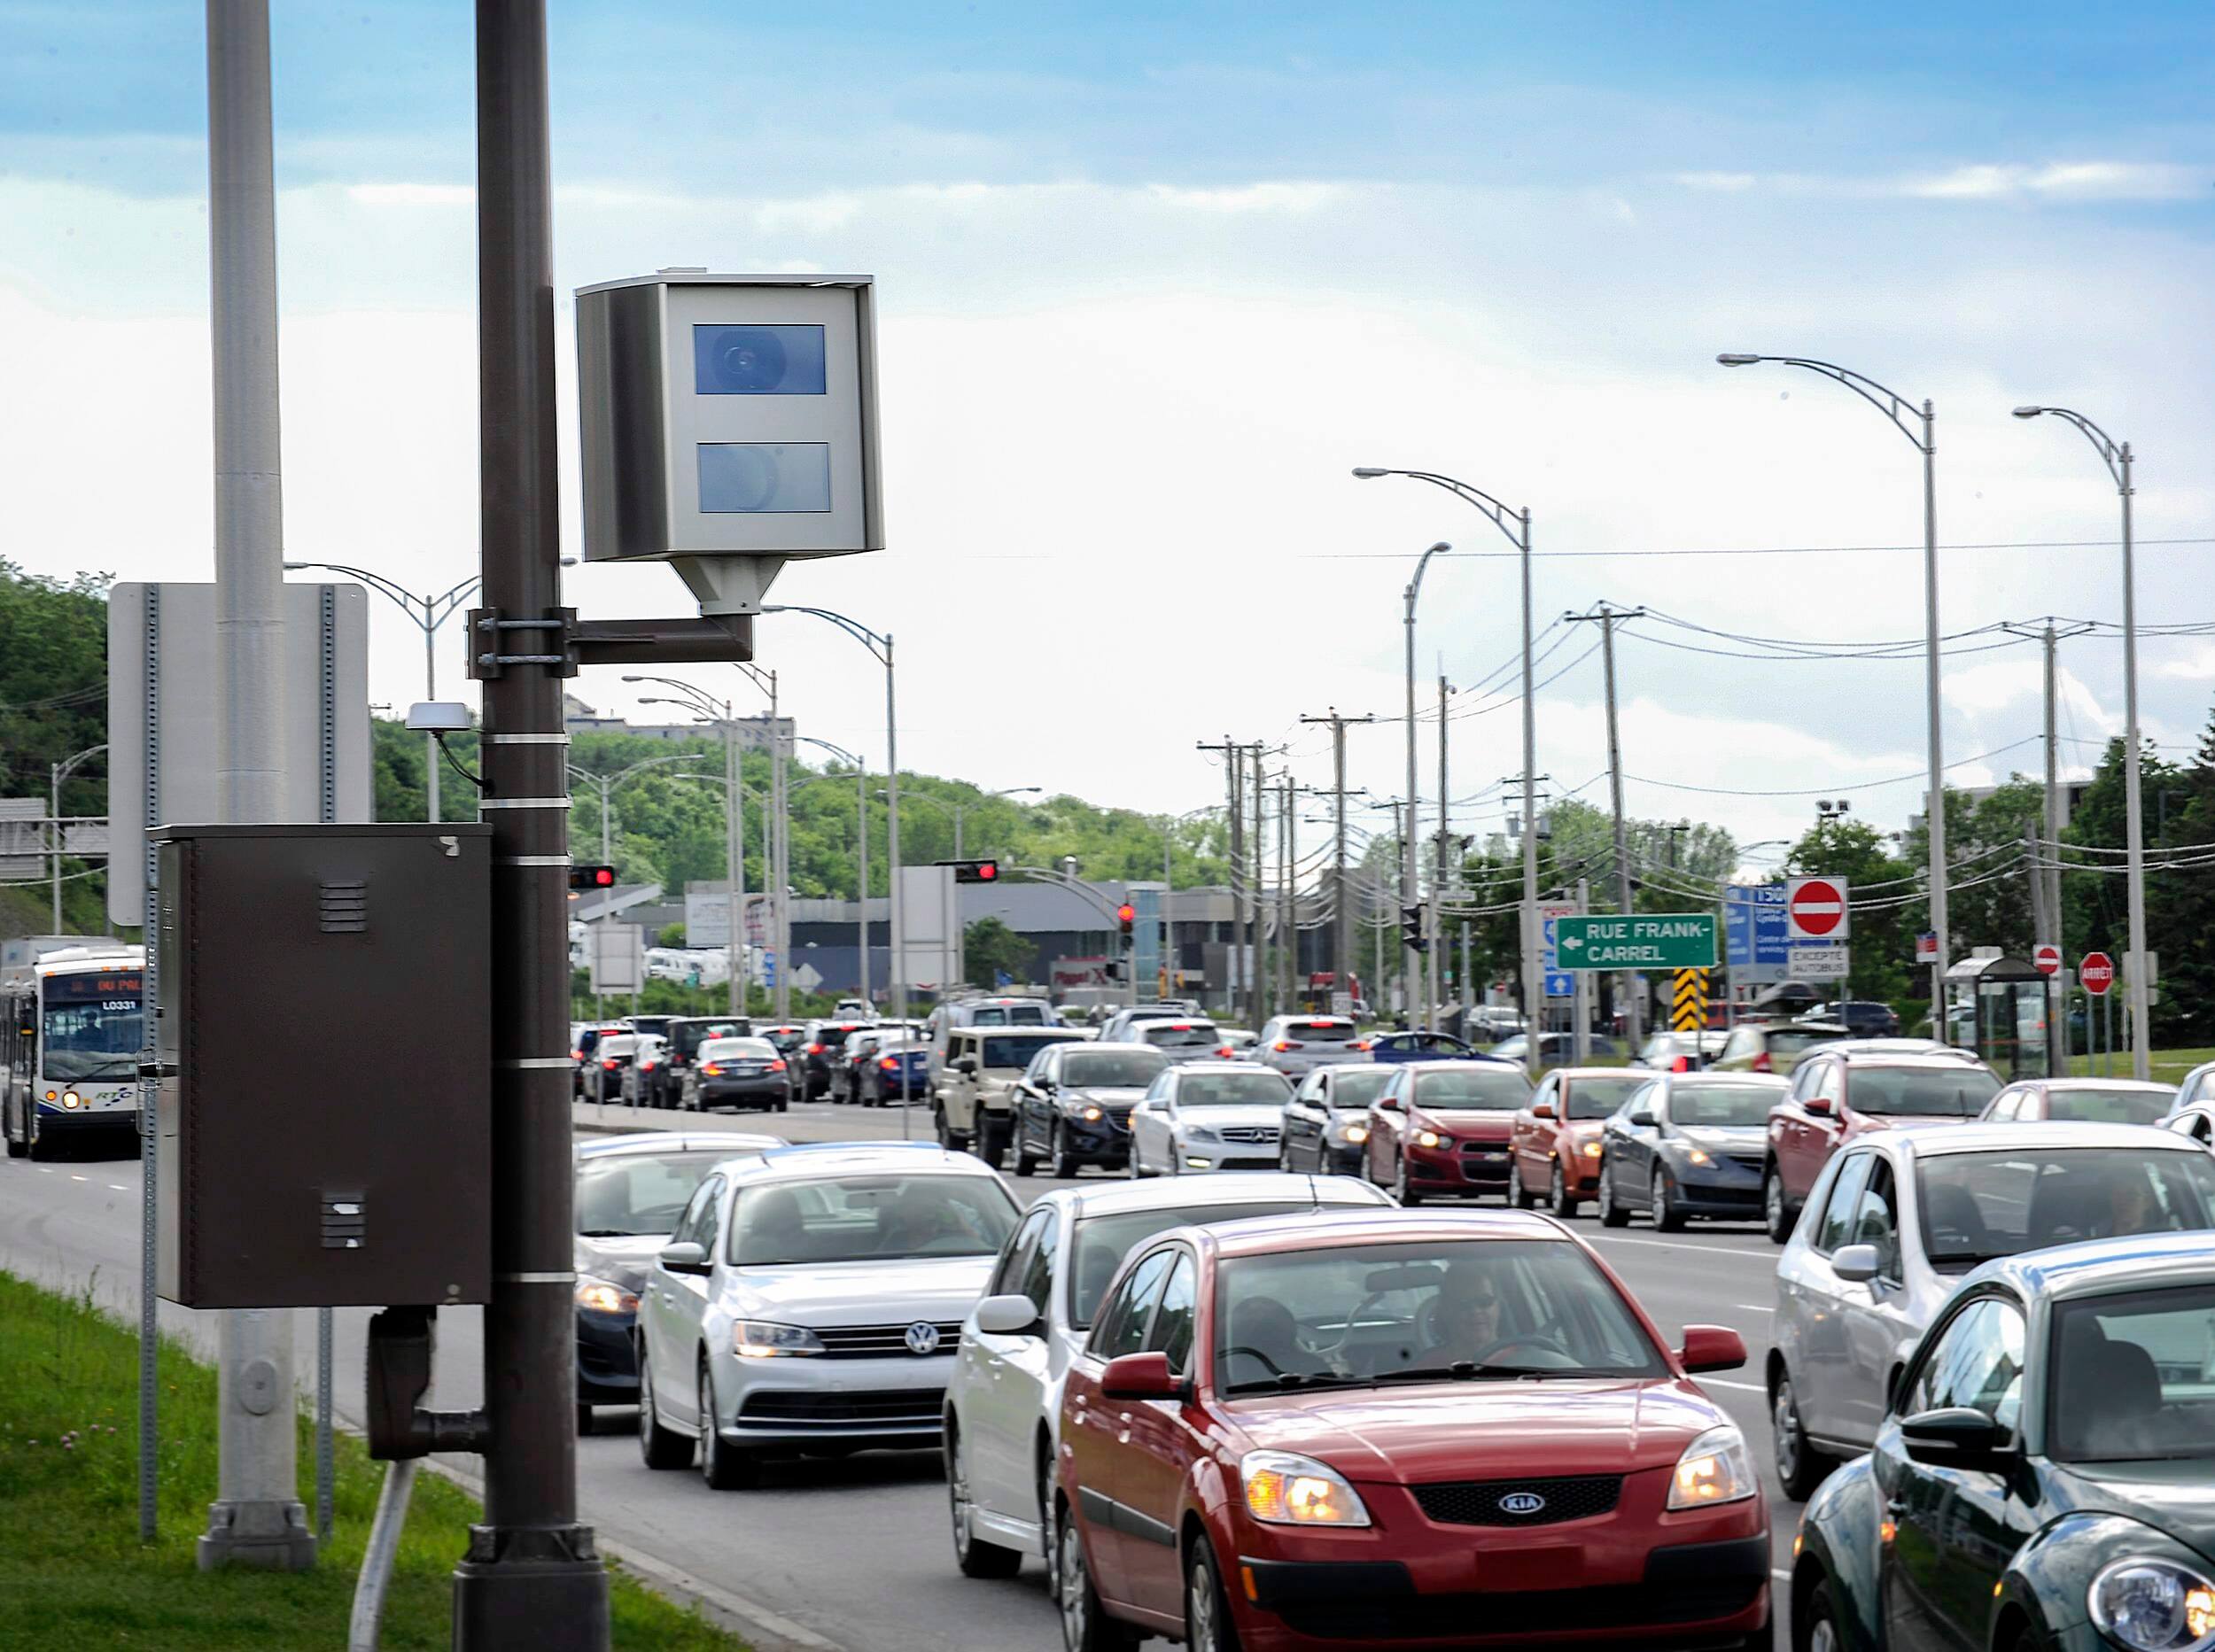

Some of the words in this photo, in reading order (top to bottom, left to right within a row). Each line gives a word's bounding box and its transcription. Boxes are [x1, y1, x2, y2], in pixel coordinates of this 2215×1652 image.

[1587, 923, 1628, 939] RUE
[1634, 922, 1711, 938] FRANK-
[1587, 946, 1666, 962] CARREL
[1793, 963, 1844, 973] AUTOBUS
[1506, 1497, 1538, 1509] KIA
